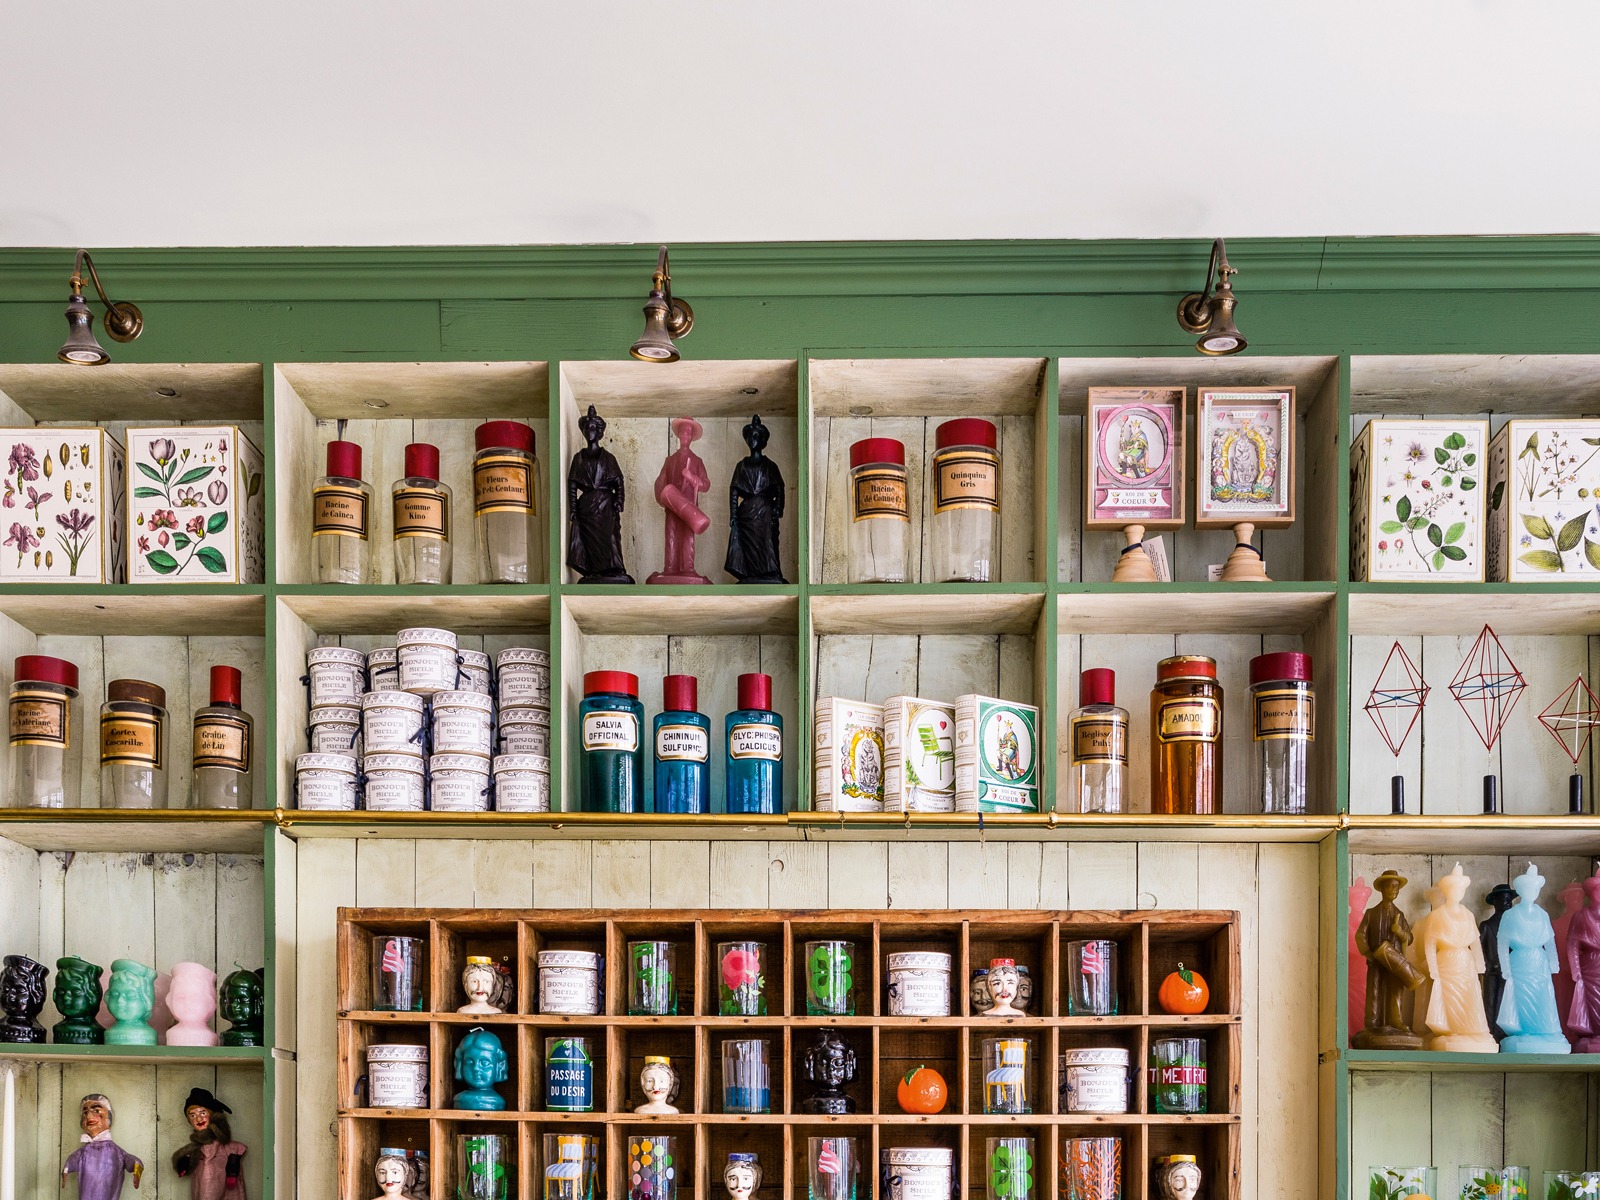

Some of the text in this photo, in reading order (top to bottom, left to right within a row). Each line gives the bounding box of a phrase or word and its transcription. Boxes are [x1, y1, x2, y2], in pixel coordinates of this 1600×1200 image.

[486, 475, 509, 484] Fleurs
[950, 471, 987, 480] Quinquina
[871, 485, 895, 493] Racine
[325, 500, 350, 510] Racine
[404, 503, 431, 511] Gomme
[321, 509, 330, 518] de
[409, 512, 426, 520] Kino
[316, 675, 351, 683] BONJOUR
[17, 709, 41, 717] Racine
[595, 721, 623, 729] SALVIA
[111, 728, 136, 736] Cortex
[201, 730, 227, 740] Graine
[663, 732, 700, 741] CHININUM
[509, 737, 543, 745] BONJOUR
[202, 742, 225, 750] de Lin
[739, 742, 777, 752] CALCICUS
[303, 783, 338, 791] BONJOUR
[436, 783, 471, 791] BONJOUR
[550, 1069, 585, 1081] PASSAGE
[550, 1085, 585, 1098] DU DESIR
